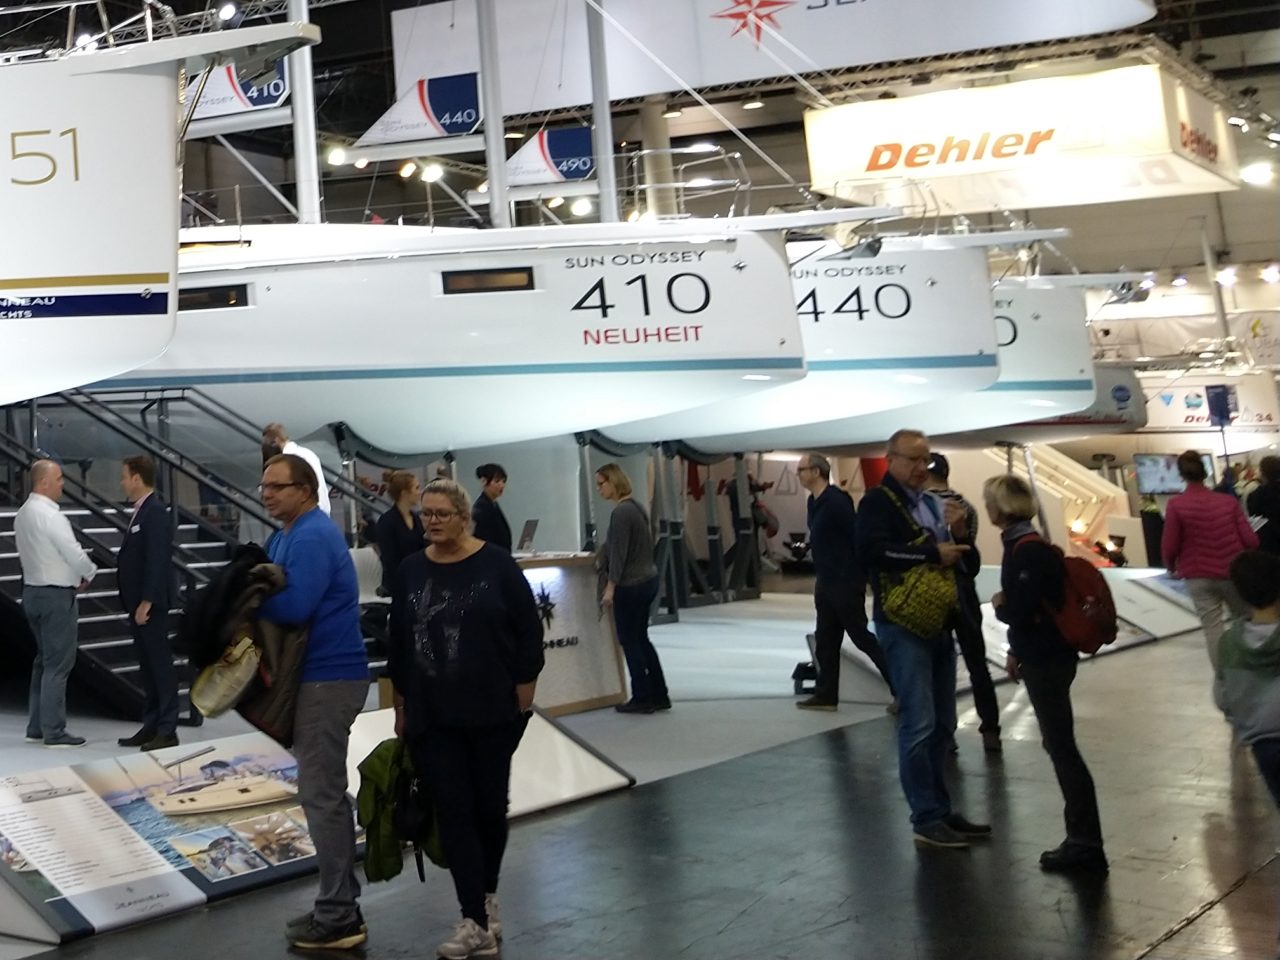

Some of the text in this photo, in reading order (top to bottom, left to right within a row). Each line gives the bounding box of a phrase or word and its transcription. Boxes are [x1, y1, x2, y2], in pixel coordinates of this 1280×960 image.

[246, 79, 285, 99] 410
[439, 108, 476, 126] 440
[10, 127, 80, 186] 51
[864, 128, 1056, 173] Dehler
[557, 157, 591, 173] 490
[564, 249, 707, 269] SUN ODYSSEY
[790, 264, 907, 280] UN ODYSSEY
[570, 271, 711, 319] 410
[796, 283, 912, 323] 440
[582, 325, 703, 345] NEUHEIT
